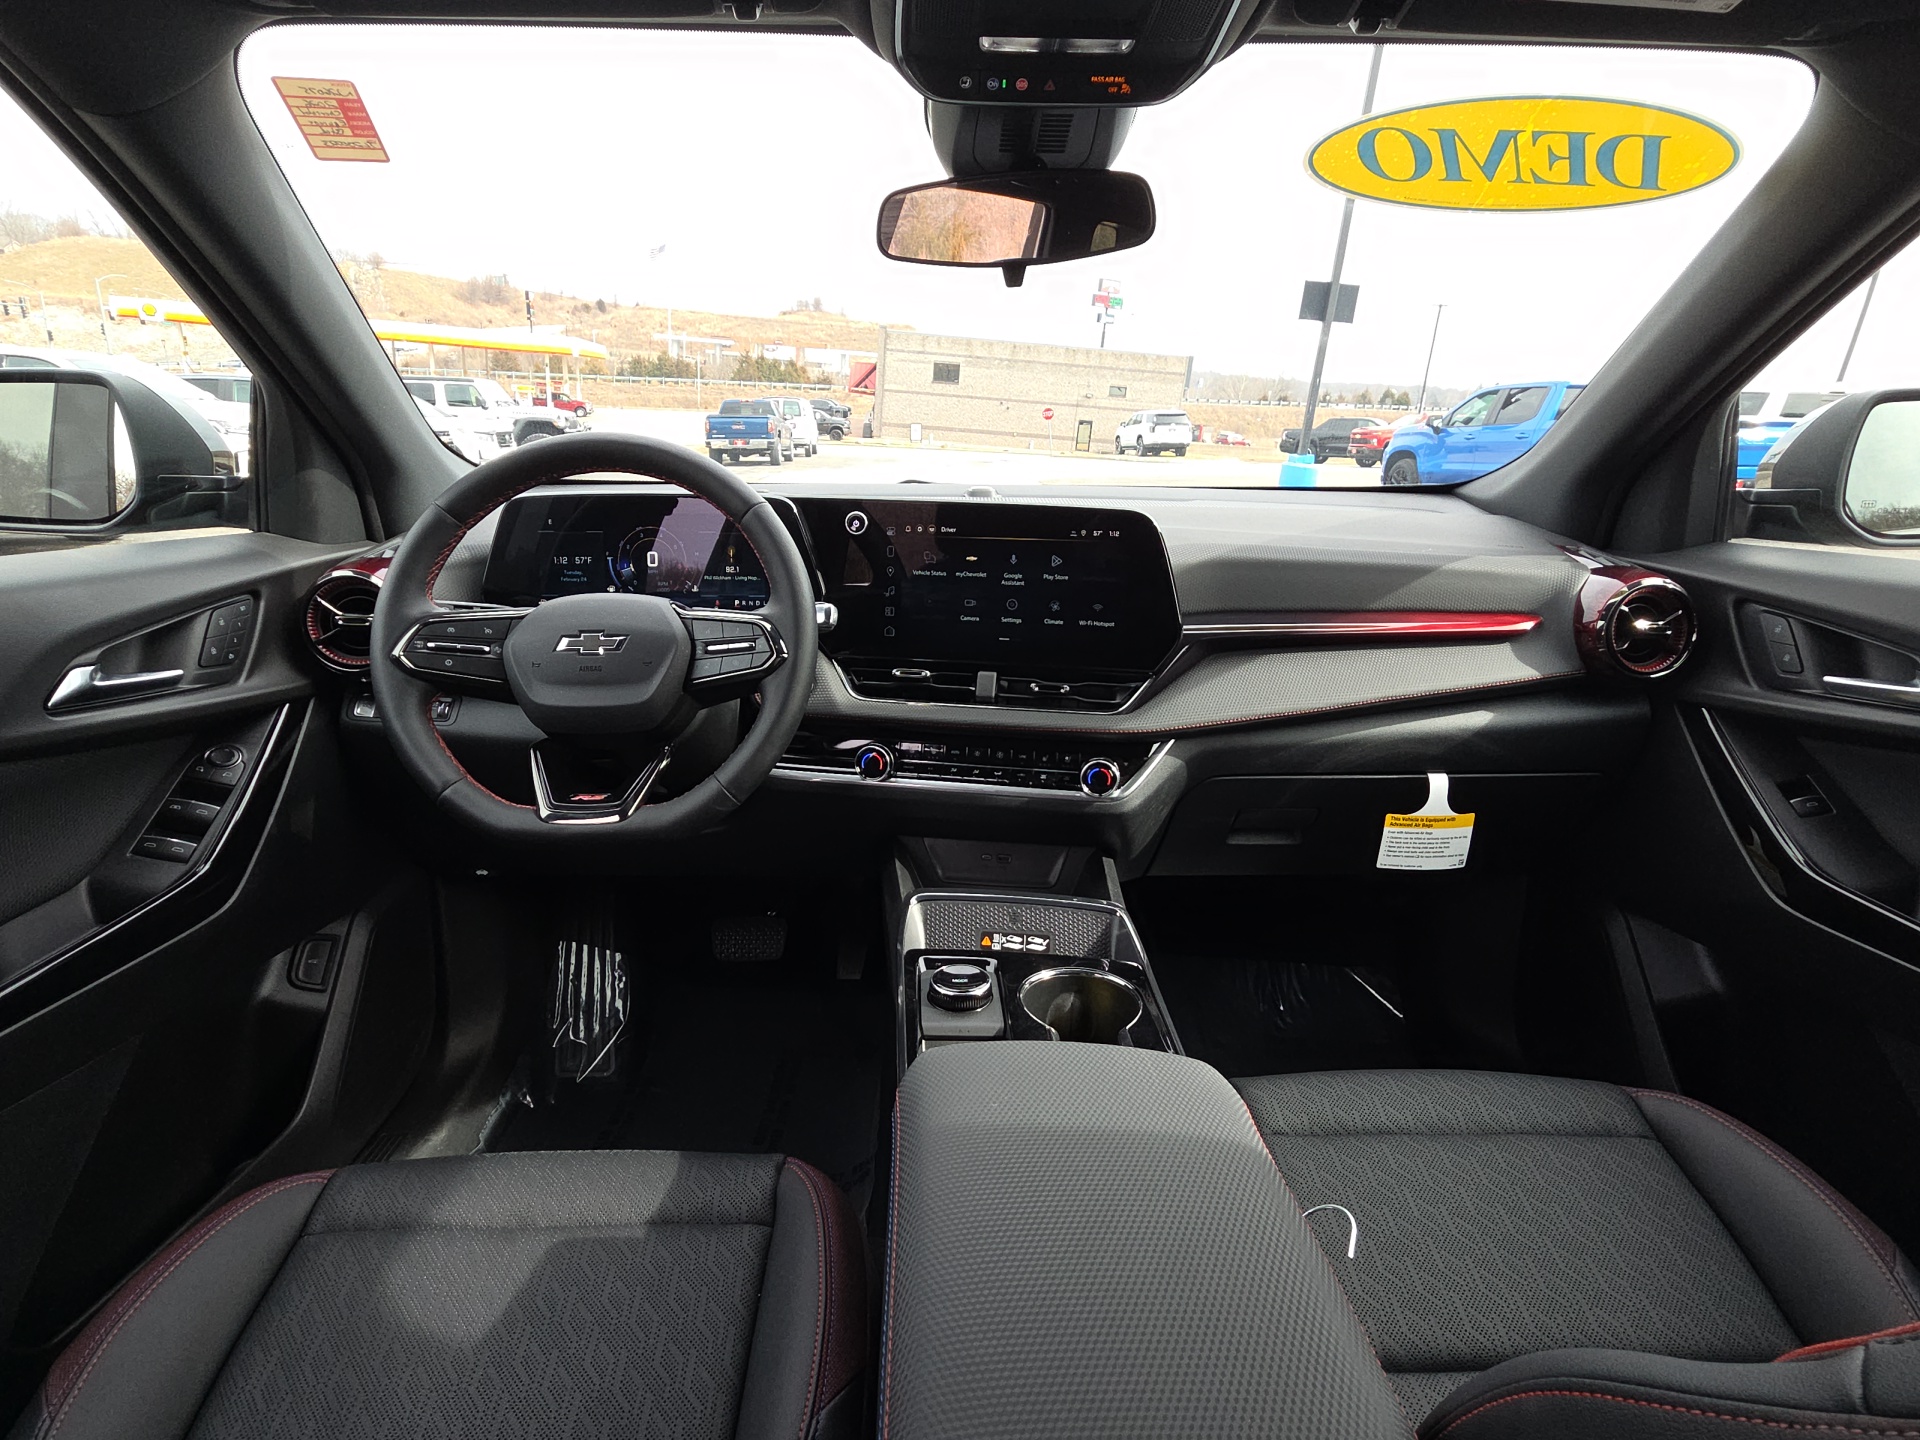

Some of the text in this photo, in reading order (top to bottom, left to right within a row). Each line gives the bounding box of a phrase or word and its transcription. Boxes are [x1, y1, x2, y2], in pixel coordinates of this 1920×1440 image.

[553, 556, 592, 565] 1:12 57°F
[647, 551, 658, 567] 0
[1003, 572, 1023, 580] Google
[1043, 573, 1054, 581] Play
[1001, 616, 1022, 624] Settings
[1093, 620, 1115, 628] Hotspot
[578, 665, 603, 673] AIRBAG
